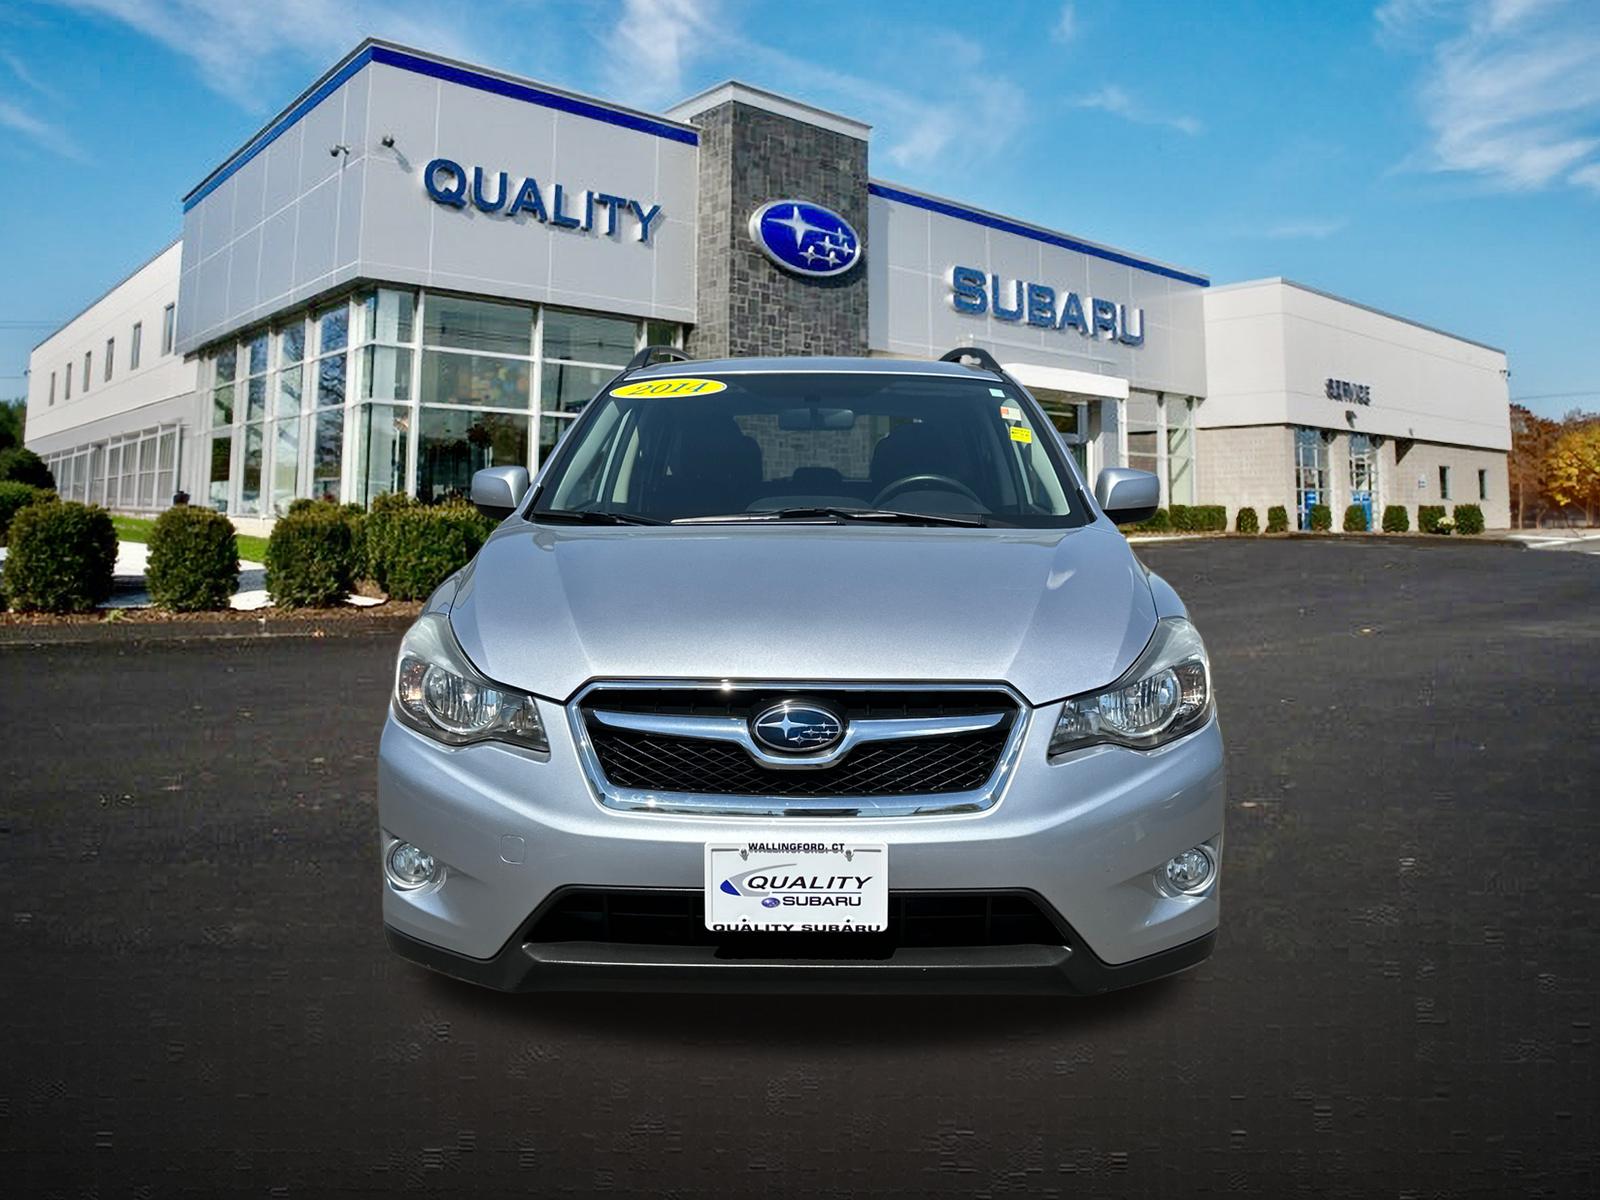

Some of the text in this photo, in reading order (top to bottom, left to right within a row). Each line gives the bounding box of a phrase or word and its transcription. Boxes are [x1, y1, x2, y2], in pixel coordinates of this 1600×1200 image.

[424, 158, 662, 243] QUALITY
[949, 265, 1145, 346] SUBARU
[628, 382, 708, 396] 2014
[831, 844, 845, 852] CT
[747, 876, 873, 890] QUALITY
[783, 896, 861, 907] SUBARU
[713, 924, 881, 932] QUALITY SUBARU
